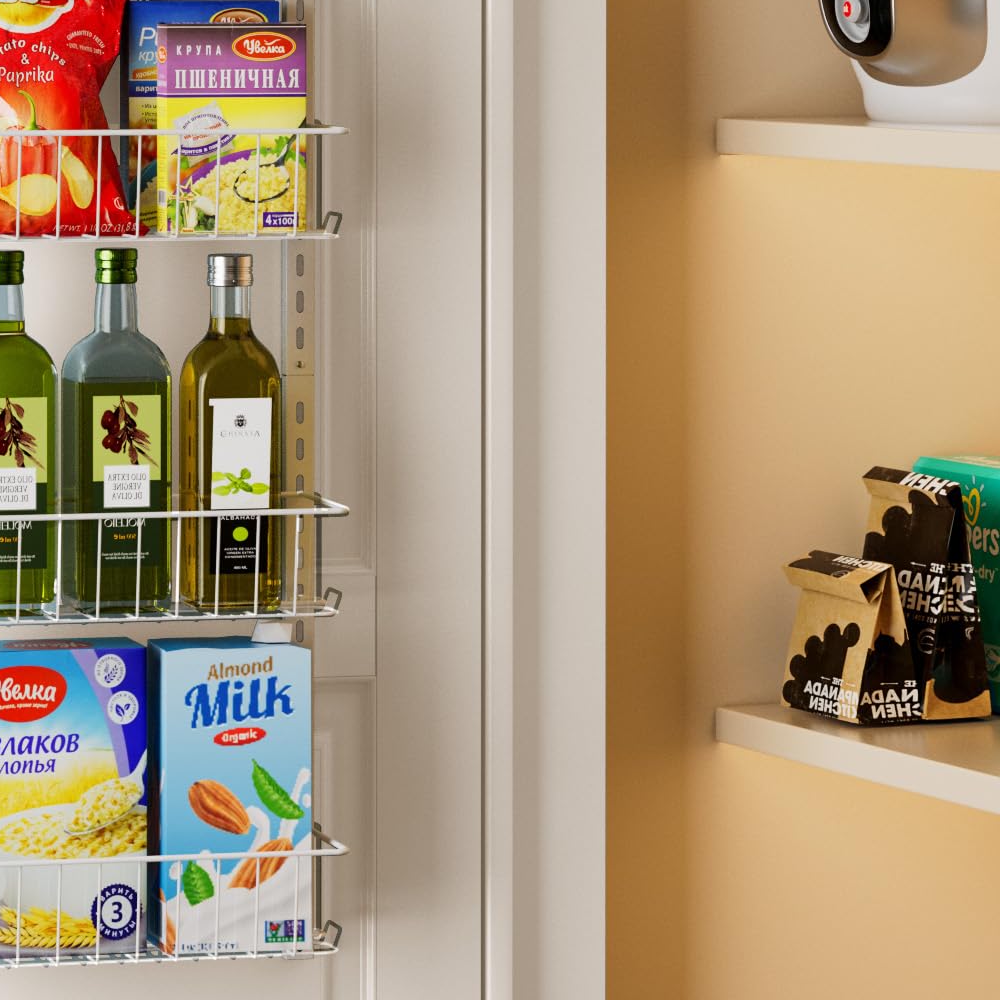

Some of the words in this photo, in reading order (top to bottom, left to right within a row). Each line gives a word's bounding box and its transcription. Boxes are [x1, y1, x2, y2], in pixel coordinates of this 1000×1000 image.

[31, 41, 66, 66] chips
[175, 45, 222, 56] КРУПА
[243, 38, 286, 55] Увелка
[20, 53, 30, 65] &
[174, 68, 300, 90] ПШЕНИЧНАЯ
[207, 655, 274, 681] Almond
[184, 675, 295, 729] Milk
[221, 728, 258, 744] Organic
[111, 901, 123, 923] 3
